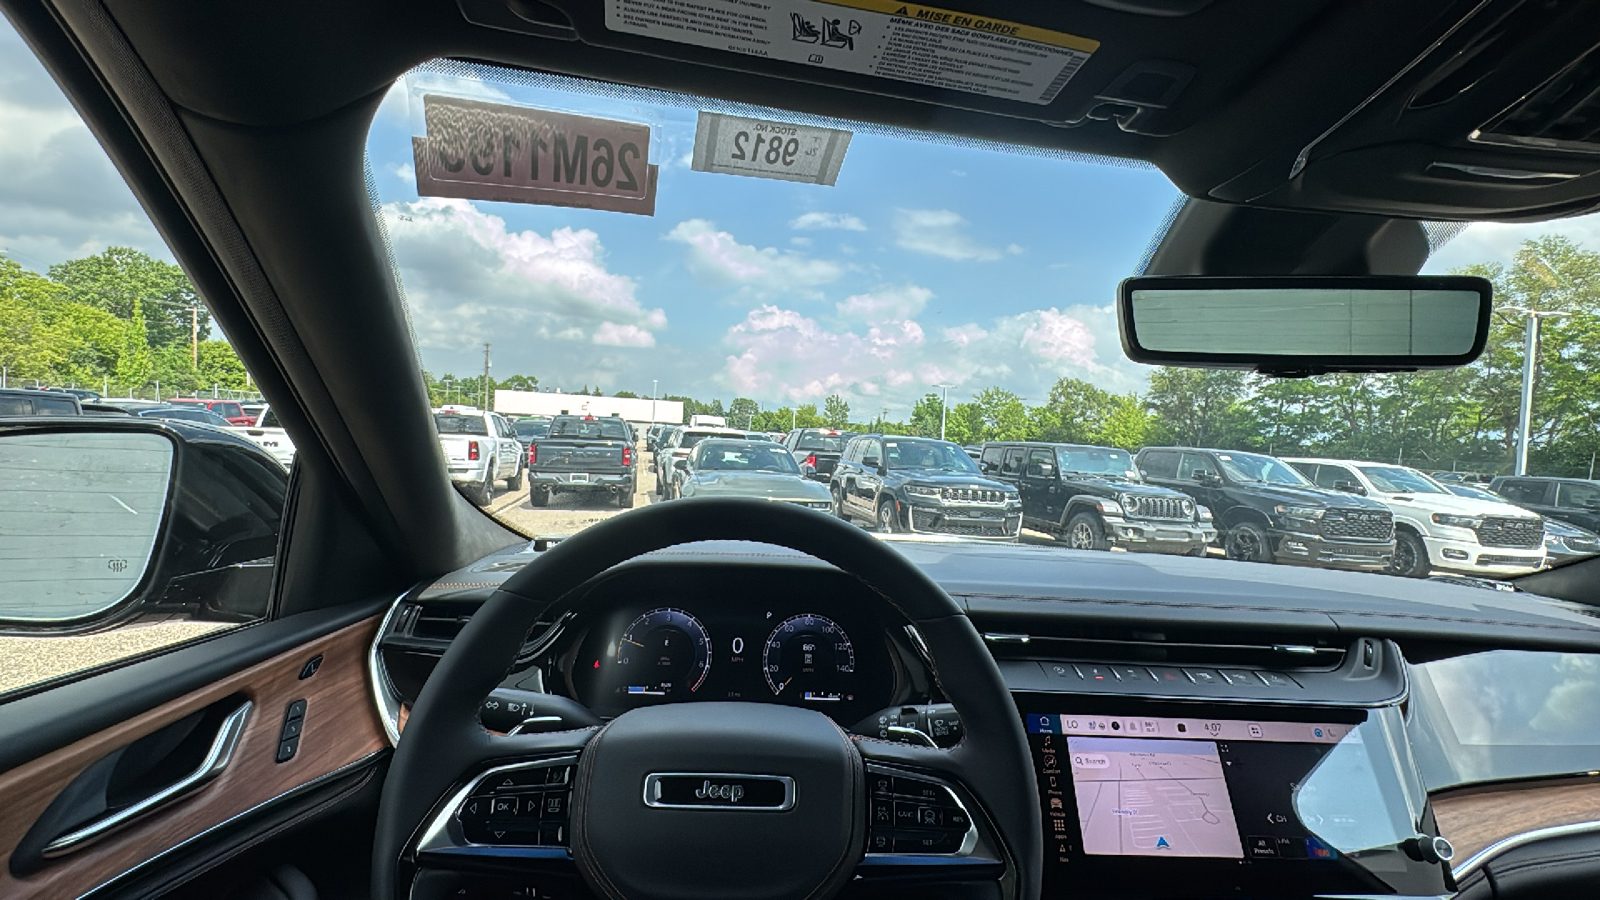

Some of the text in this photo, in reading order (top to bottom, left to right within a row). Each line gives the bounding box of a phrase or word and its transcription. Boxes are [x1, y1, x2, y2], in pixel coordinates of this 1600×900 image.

[916, 9, 1020, 35] MISE EN GARDE
[1347, 512, 1380, 521] RAM
[1503, 522, 1534, 530] RAM
[766, 611, 772, 619] P
[732, 637, 744, 654] 0
[779, 682, 784, 690] 0
[1066, 720, 1078, 729] LO
[1204, 722, 1222, 732] 4:07
[1084, 757, 1106, 765] Search
[695, 780, 744, 802] Jeep
[497, 803, 509, 811] OK
[1275, 814, 1287, 822] CH
